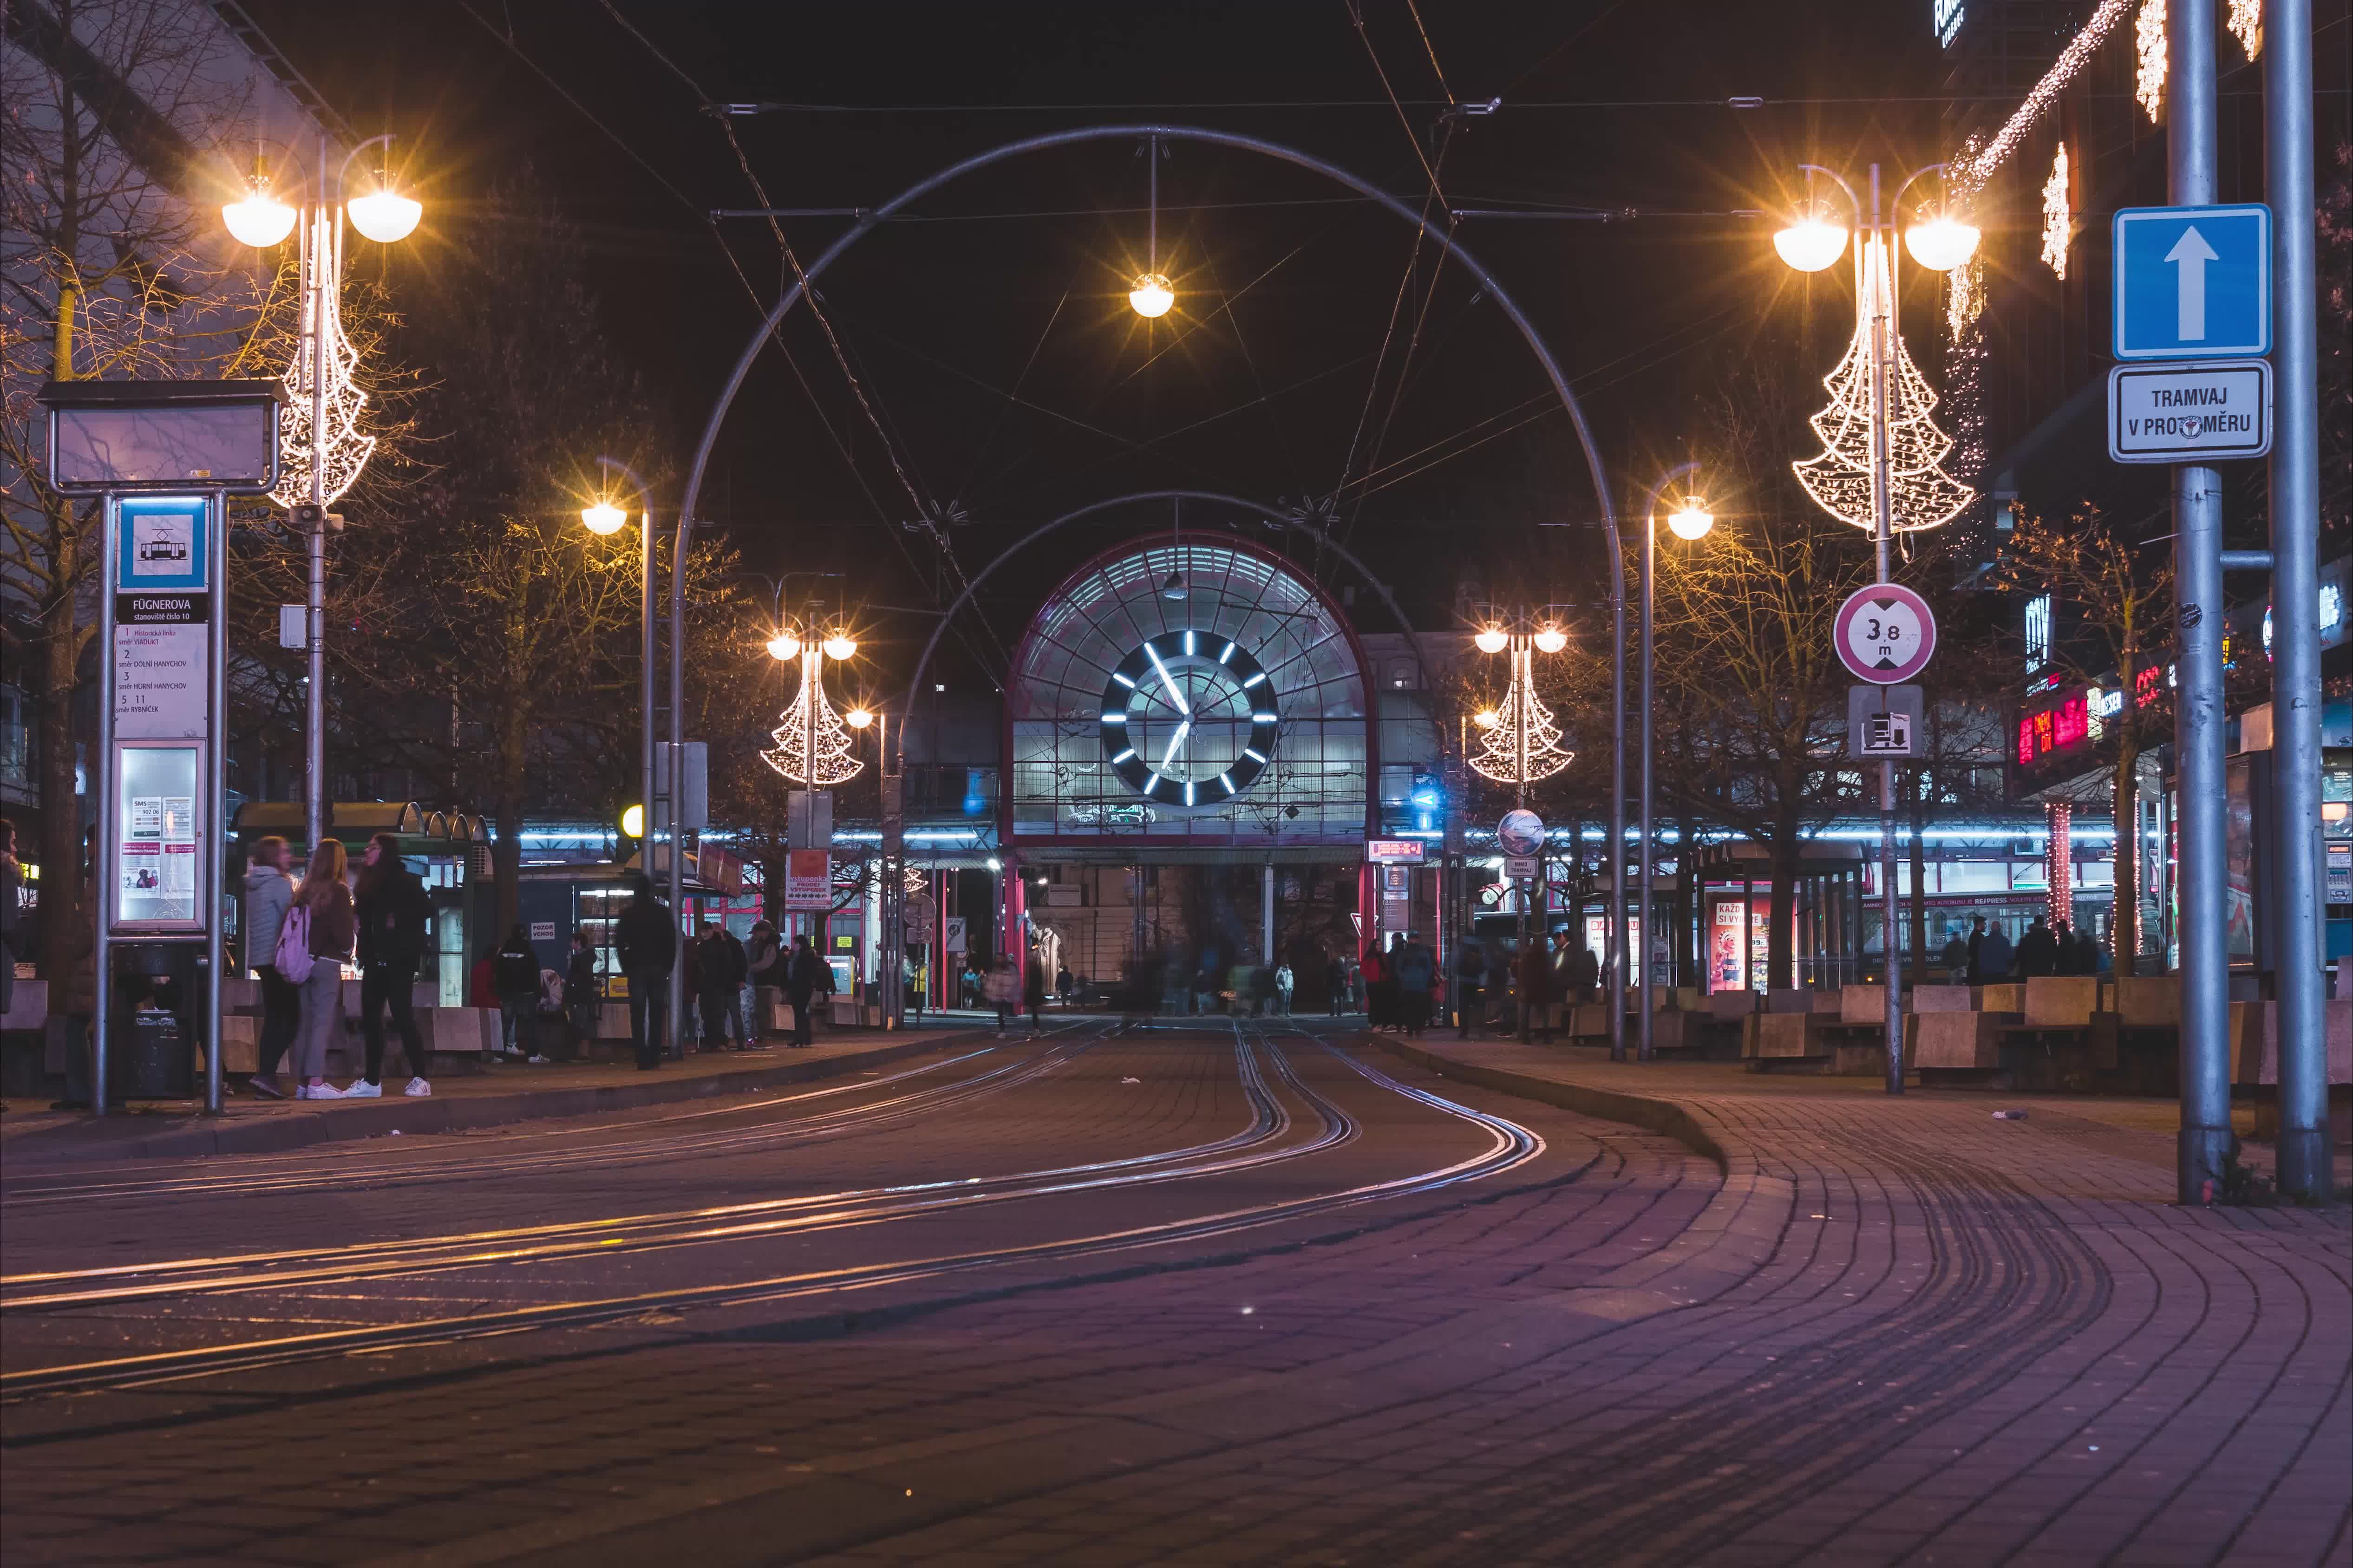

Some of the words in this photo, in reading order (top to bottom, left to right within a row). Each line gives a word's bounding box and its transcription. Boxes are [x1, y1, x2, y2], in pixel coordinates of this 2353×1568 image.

[2151, 387, 2227, 407] TRAMVAJ
[2129, 419, 2138, 436] V
[133, 598, 190, 610] FÜGNEROVA
[1879, 646, 1891, 655] m
[124, 672, 129, 680] 3
[122, 695, 127, 704] 5
[136, 695, 145, 704] 11
